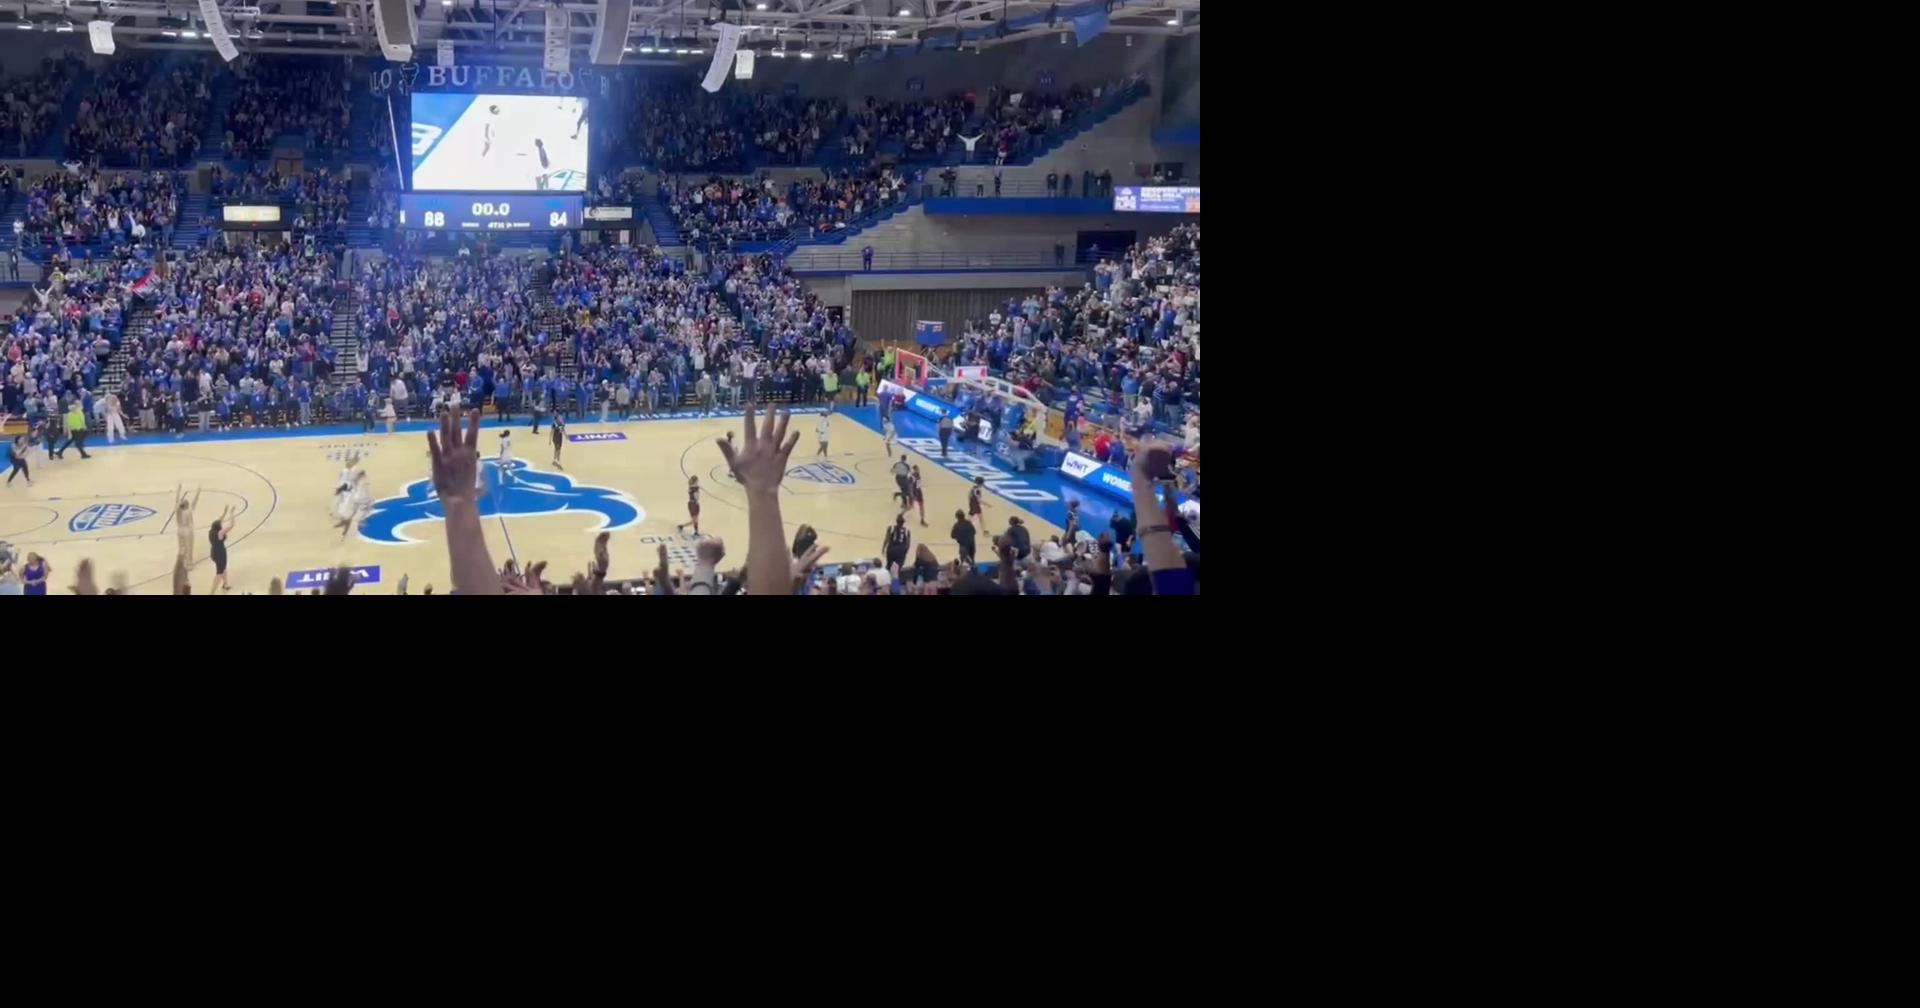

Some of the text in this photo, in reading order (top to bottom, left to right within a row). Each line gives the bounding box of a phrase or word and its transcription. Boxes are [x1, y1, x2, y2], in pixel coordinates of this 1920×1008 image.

[427, 64, 575, 90] BUFFALO
[472, 202, 510, 216] 00.0
[424, 211, 445, 227] 88
[549, 212, 567, 227] 84
